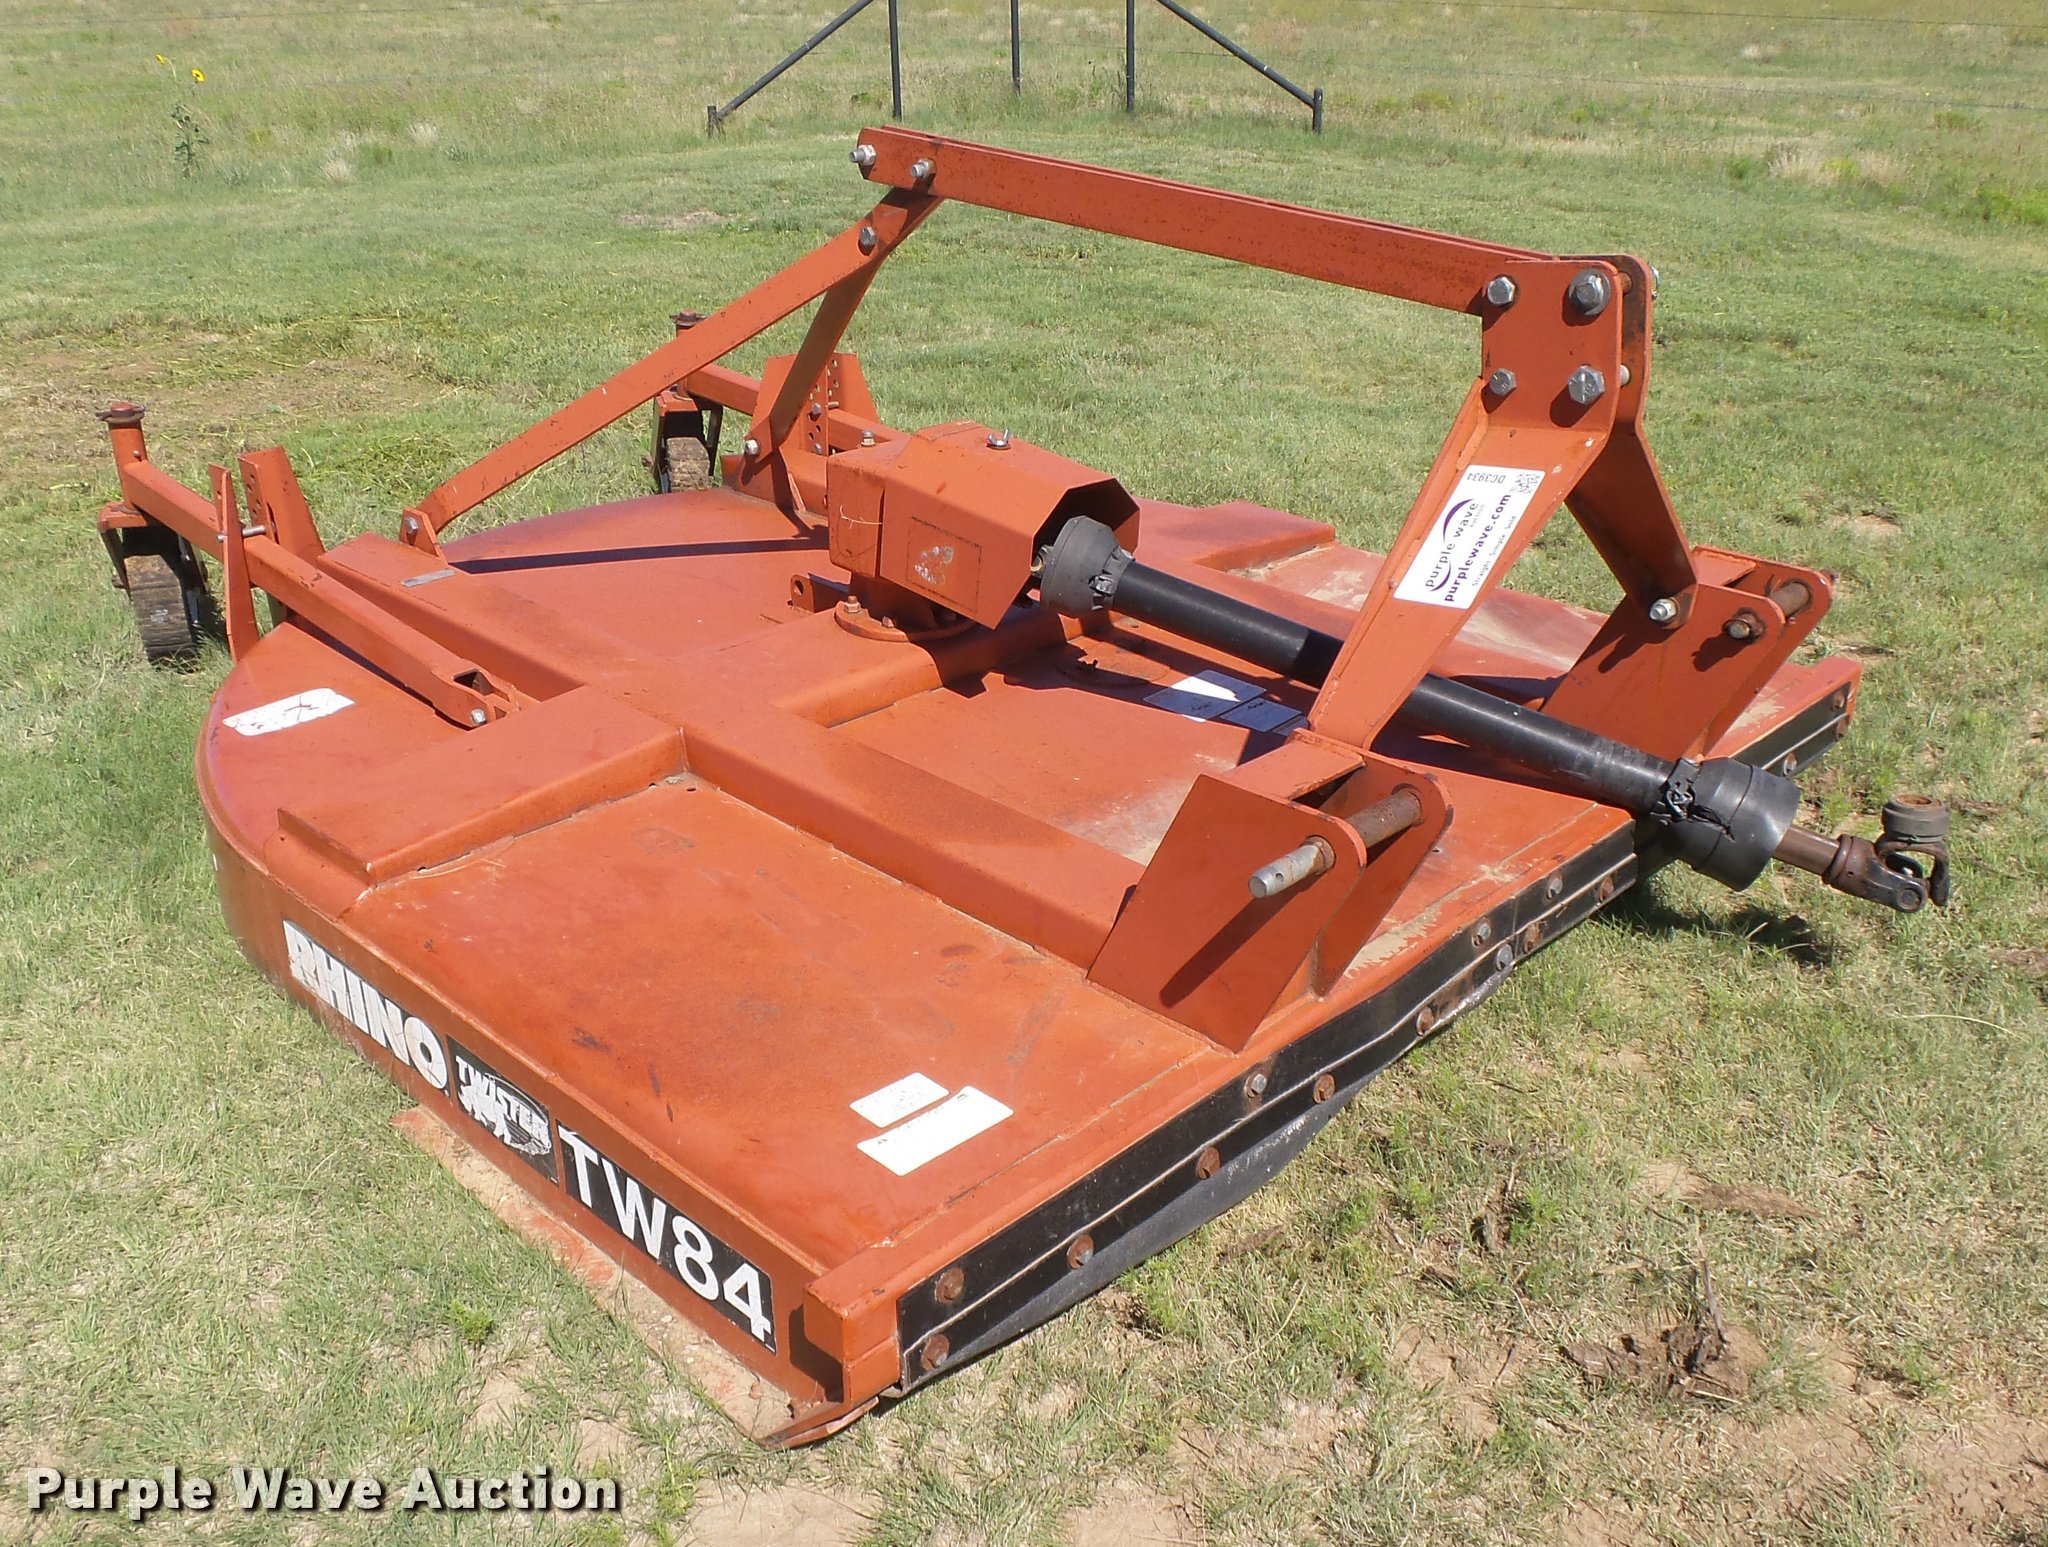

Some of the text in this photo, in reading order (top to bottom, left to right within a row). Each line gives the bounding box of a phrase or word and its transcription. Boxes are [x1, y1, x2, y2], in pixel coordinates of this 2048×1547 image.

[1425, 502, 1479, 588] purple wave
[1444, 494, 1511, 602] purplewave.com
[282, 919, 448, 1091] RHINO
[557, 1125, 772, 1342] TW84
